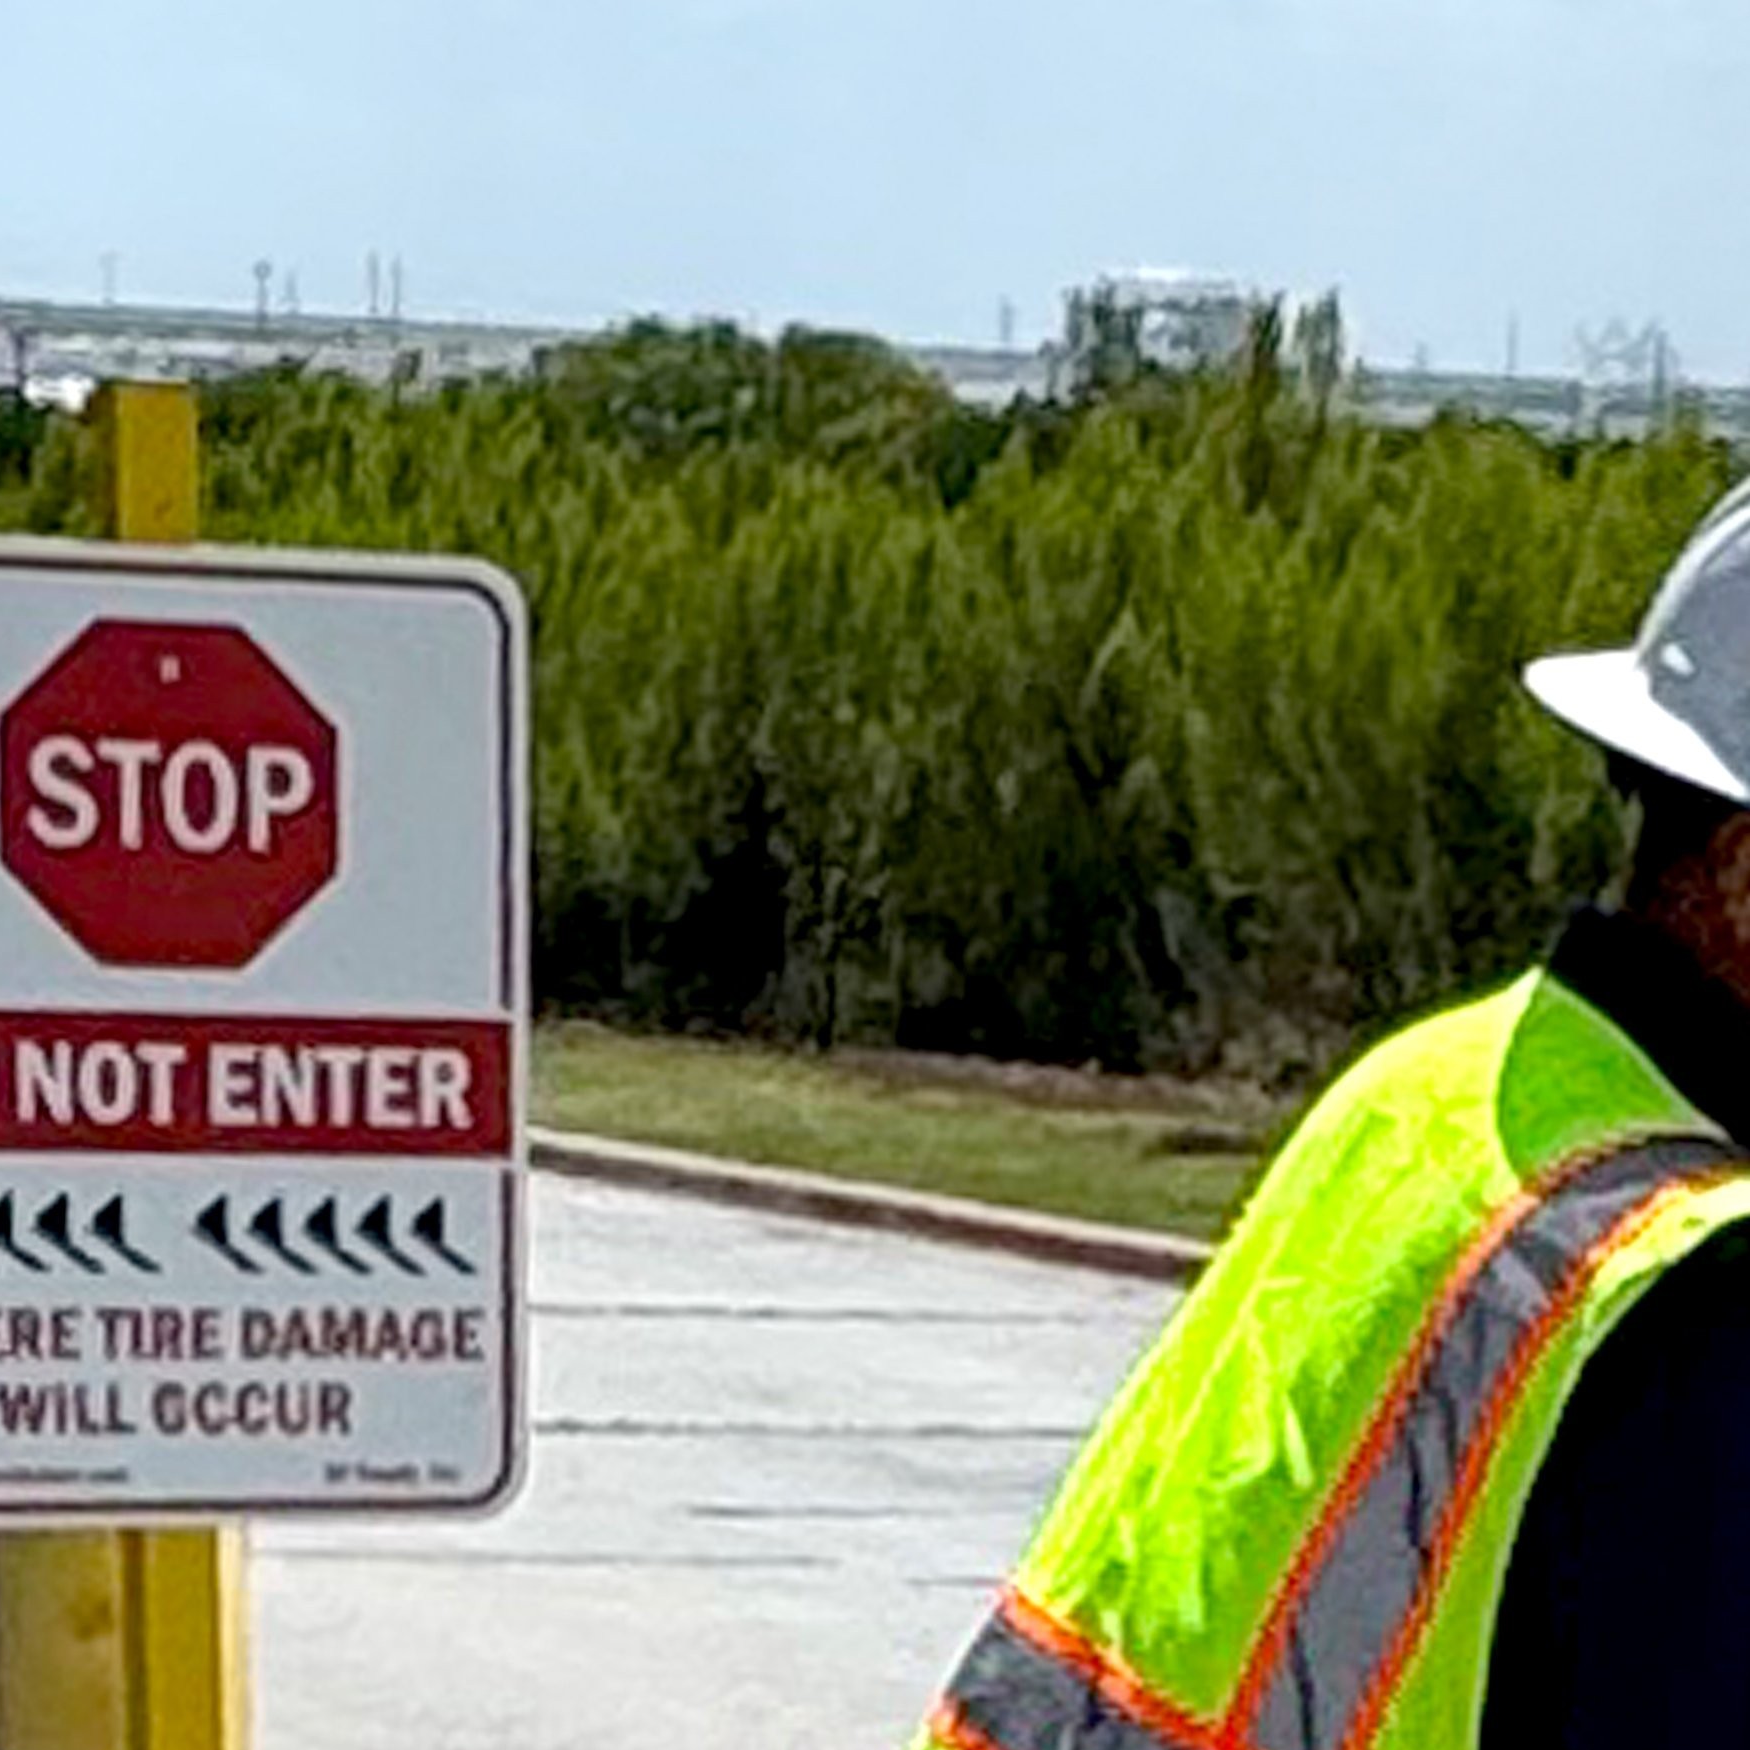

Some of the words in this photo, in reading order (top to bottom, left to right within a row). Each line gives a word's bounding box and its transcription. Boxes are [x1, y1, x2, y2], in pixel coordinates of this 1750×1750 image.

[27, 734, 314, 854] STOP
[13, 1037, 188, 1128] NOT
[206, 1042, 474, 1131] ENTER
[95, 1305, 226, 1361] TIRE
[239, 1305, 487, 1362] DAMAGE
[151, 1380, 353, 1436] OCCUR
